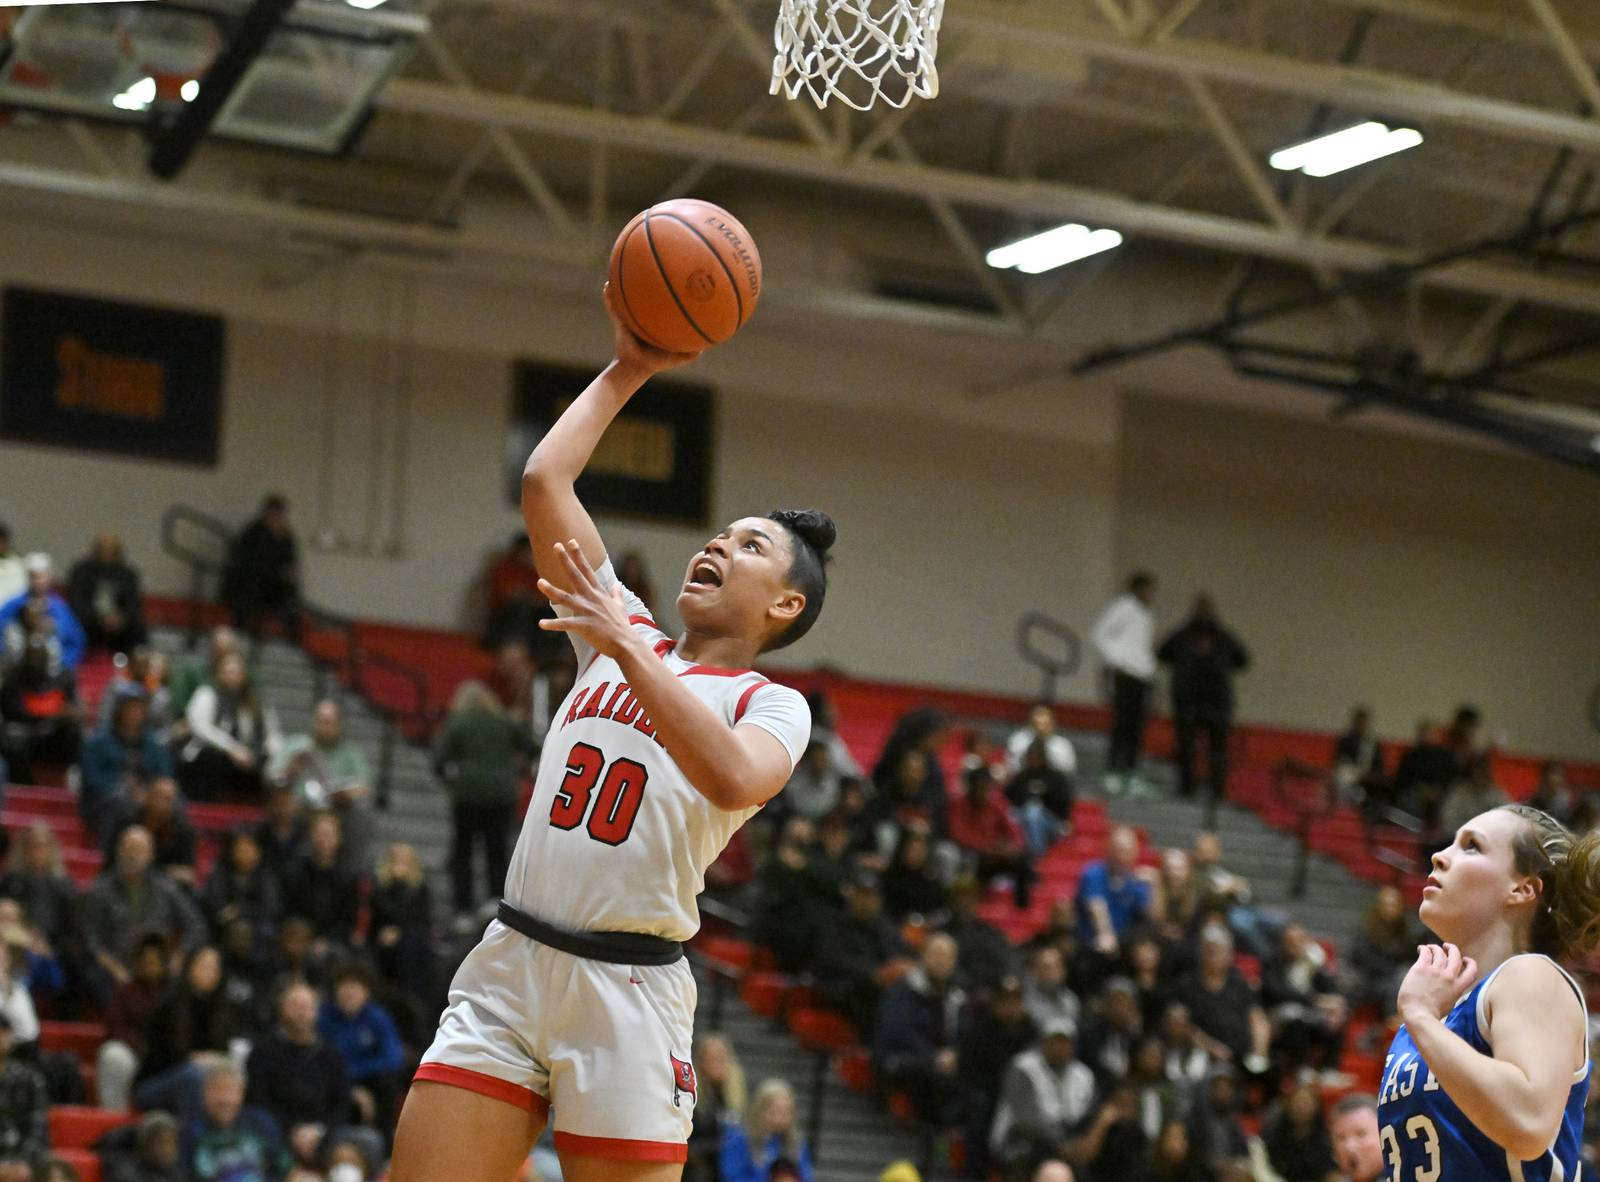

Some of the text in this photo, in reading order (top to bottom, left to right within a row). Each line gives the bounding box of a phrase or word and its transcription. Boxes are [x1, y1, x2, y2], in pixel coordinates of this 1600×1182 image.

[704, 217, 758, 297] EVOLUTION
[560, 681, 665, 749] RAID
[549, 741, 649, 847] 30
[1380, 1114, 1441, 1182] 33
